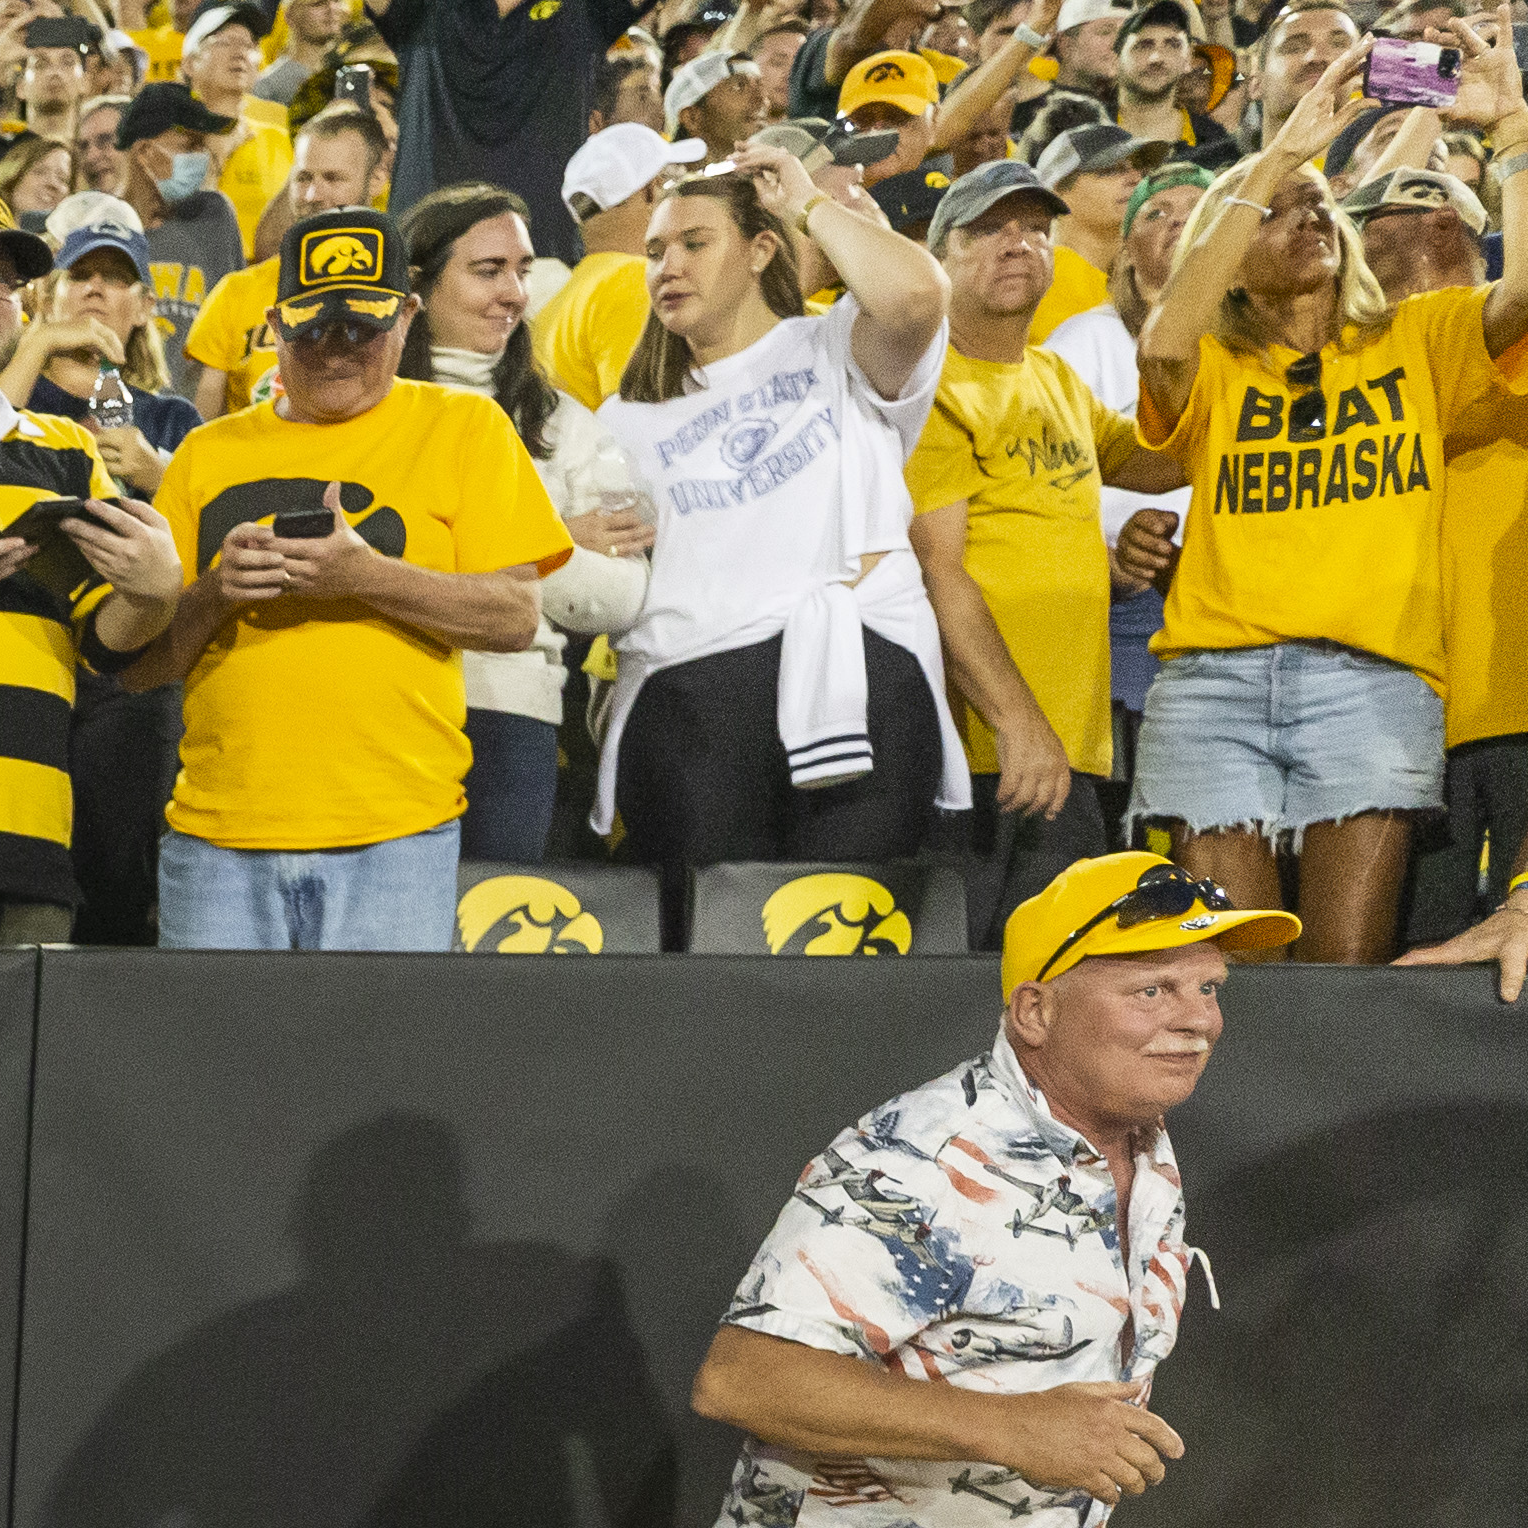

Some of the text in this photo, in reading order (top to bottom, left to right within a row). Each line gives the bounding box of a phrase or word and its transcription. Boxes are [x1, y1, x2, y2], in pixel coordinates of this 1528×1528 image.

[656, 397, 732, 470] PENN
[1236, 366, 1406, 443] BAT
[669, 406, 842, 517] UNIVERSITY
[1214, 432, 1431, 515] NEBRASKA
